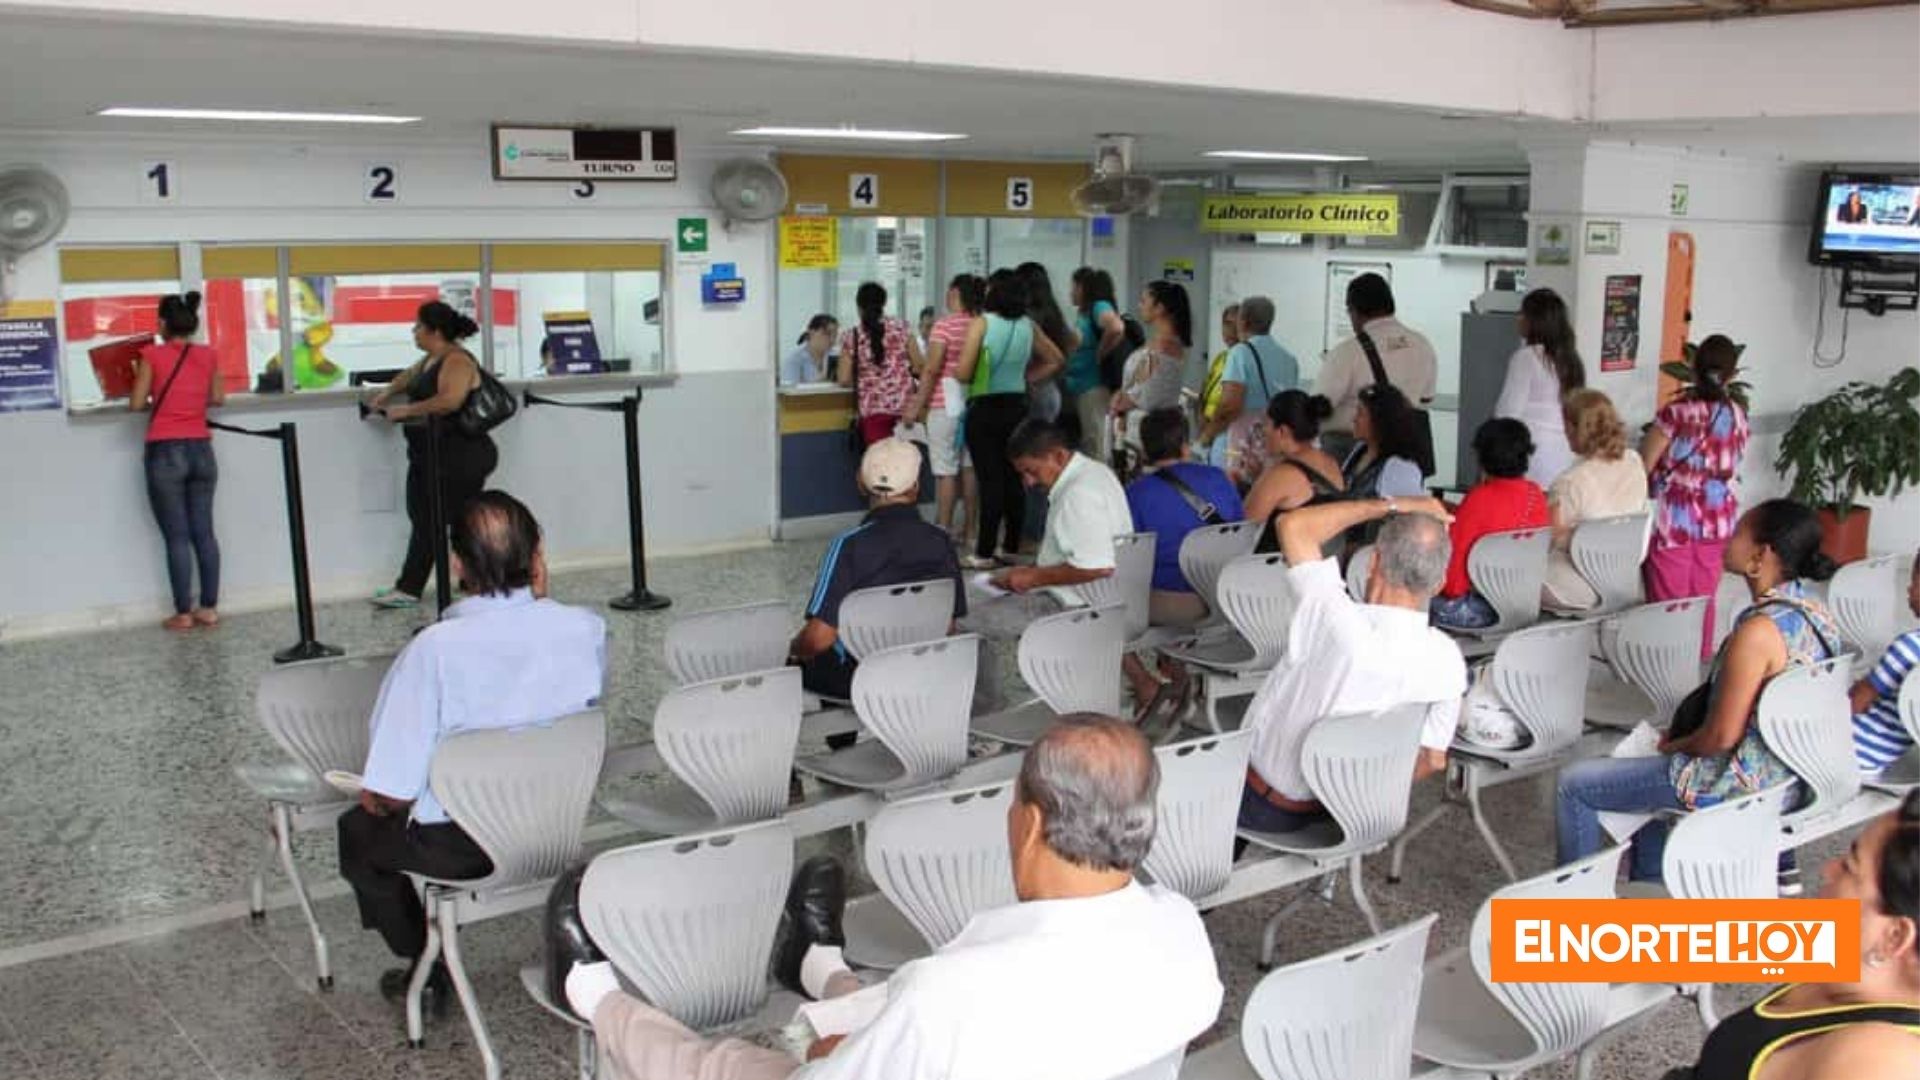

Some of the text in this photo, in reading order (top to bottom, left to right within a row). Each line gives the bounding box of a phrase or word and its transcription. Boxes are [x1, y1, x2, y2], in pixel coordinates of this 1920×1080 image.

[148, 163, 168, 198] 1
[370, 166, 396, 199] 2
[854, 177, 874, 204] 4
[1012, 182, 1029, 207] 5
[1207, 204, 1390, 221] Laboratorio Clínico
